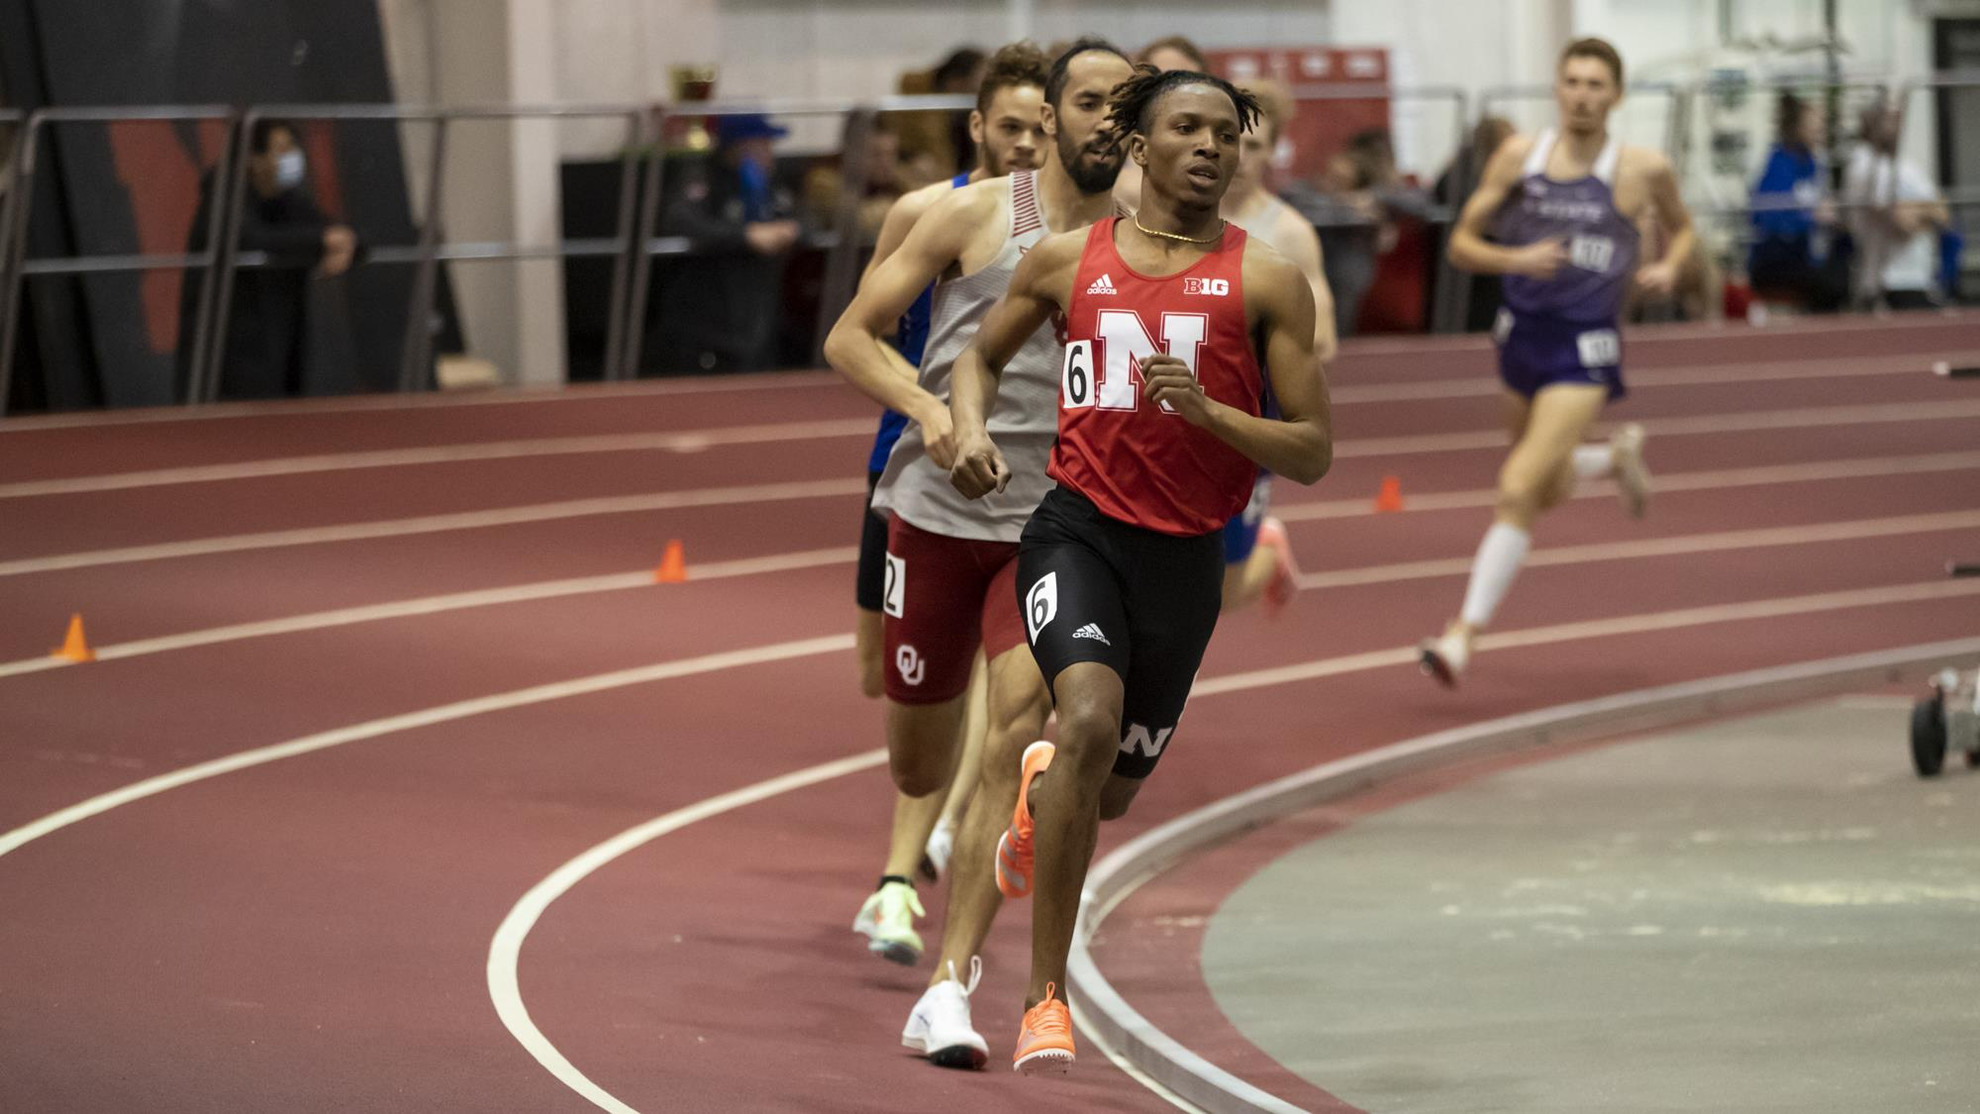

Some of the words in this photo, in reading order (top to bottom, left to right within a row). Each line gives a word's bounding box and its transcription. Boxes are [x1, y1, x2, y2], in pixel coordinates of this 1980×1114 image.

[1086, 287, 1117, 295] adidas
[1068, 345, 1087, 404] 6
[1095, 309, 1209, 415] N
[1031, 581, 1049, 632] 6
[1119, 722, 1173, 757] N
